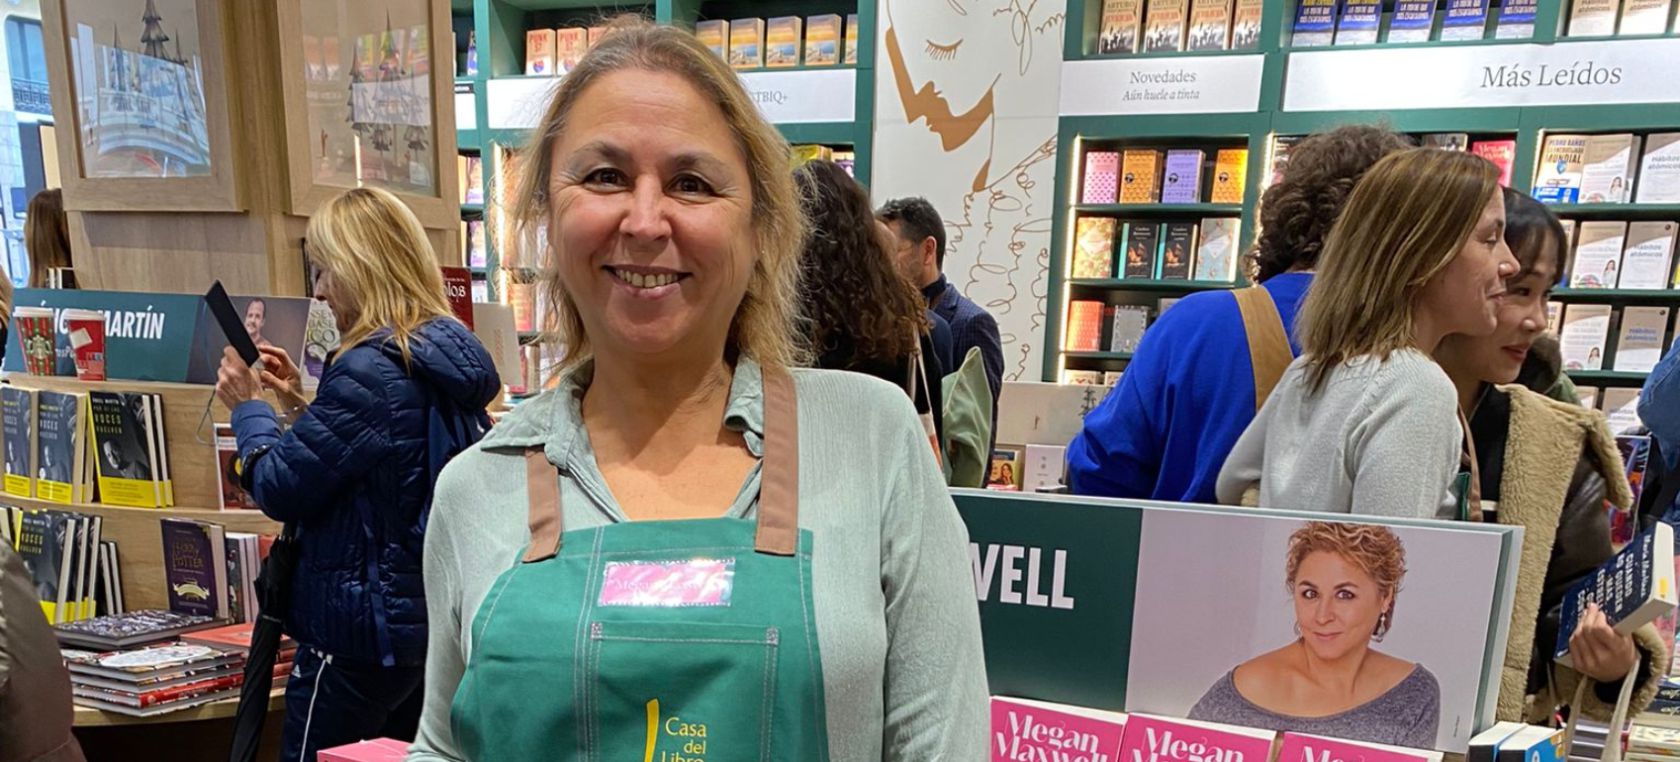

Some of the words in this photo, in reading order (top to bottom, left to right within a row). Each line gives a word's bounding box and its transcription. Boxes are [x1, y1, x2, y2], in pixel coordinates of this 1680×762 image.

[1130, 69, 1197, 84] Novedades
[1481, 64, 1531, 87] Más
[1537, 61, 1622, 86] Leídos
[752, 90, 788, 105] TBIQ+
[1122, 89, 1142, 100] Aún
[1177, 88, 1200, 100] tinta
[969, 542, 1075, 610] WELL
[1625, 553, 1634, 597] CUANDO
[1615, 570, 1624, 613] QUEDEN
[665, 716, 707, 738] Casa
[1004, 711, 1099, 754] Megan
[683, 740, 706, 754] del
